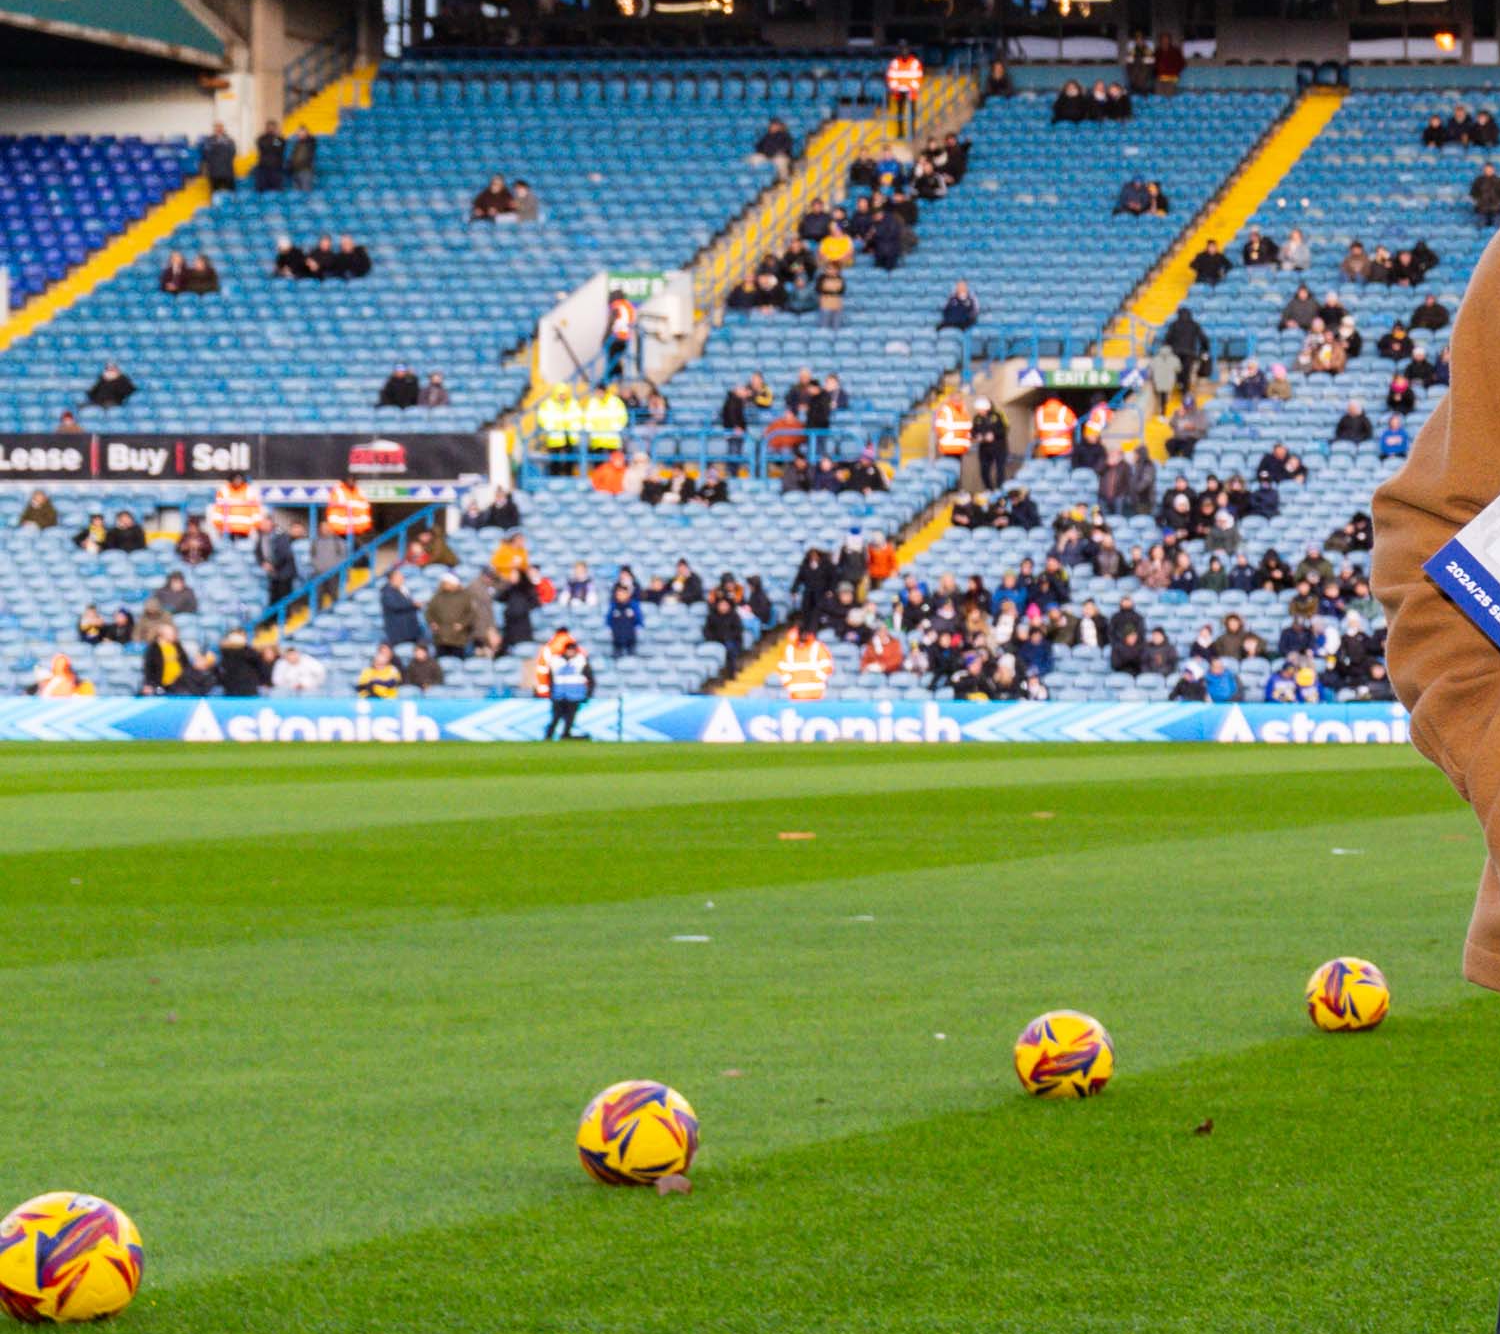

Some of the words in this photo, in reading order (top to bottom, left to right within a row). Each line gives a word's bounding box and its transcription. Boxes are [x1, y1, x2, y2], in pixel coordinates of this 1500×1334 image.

[1053, 371, 1086, 386] EXIT
[0, 444, 83, 471] Lease
[107, 443, 168, 475] Buy
[191, 442, 250, 471] Sell
[1444, 558, 1493, 609] 2024/25
